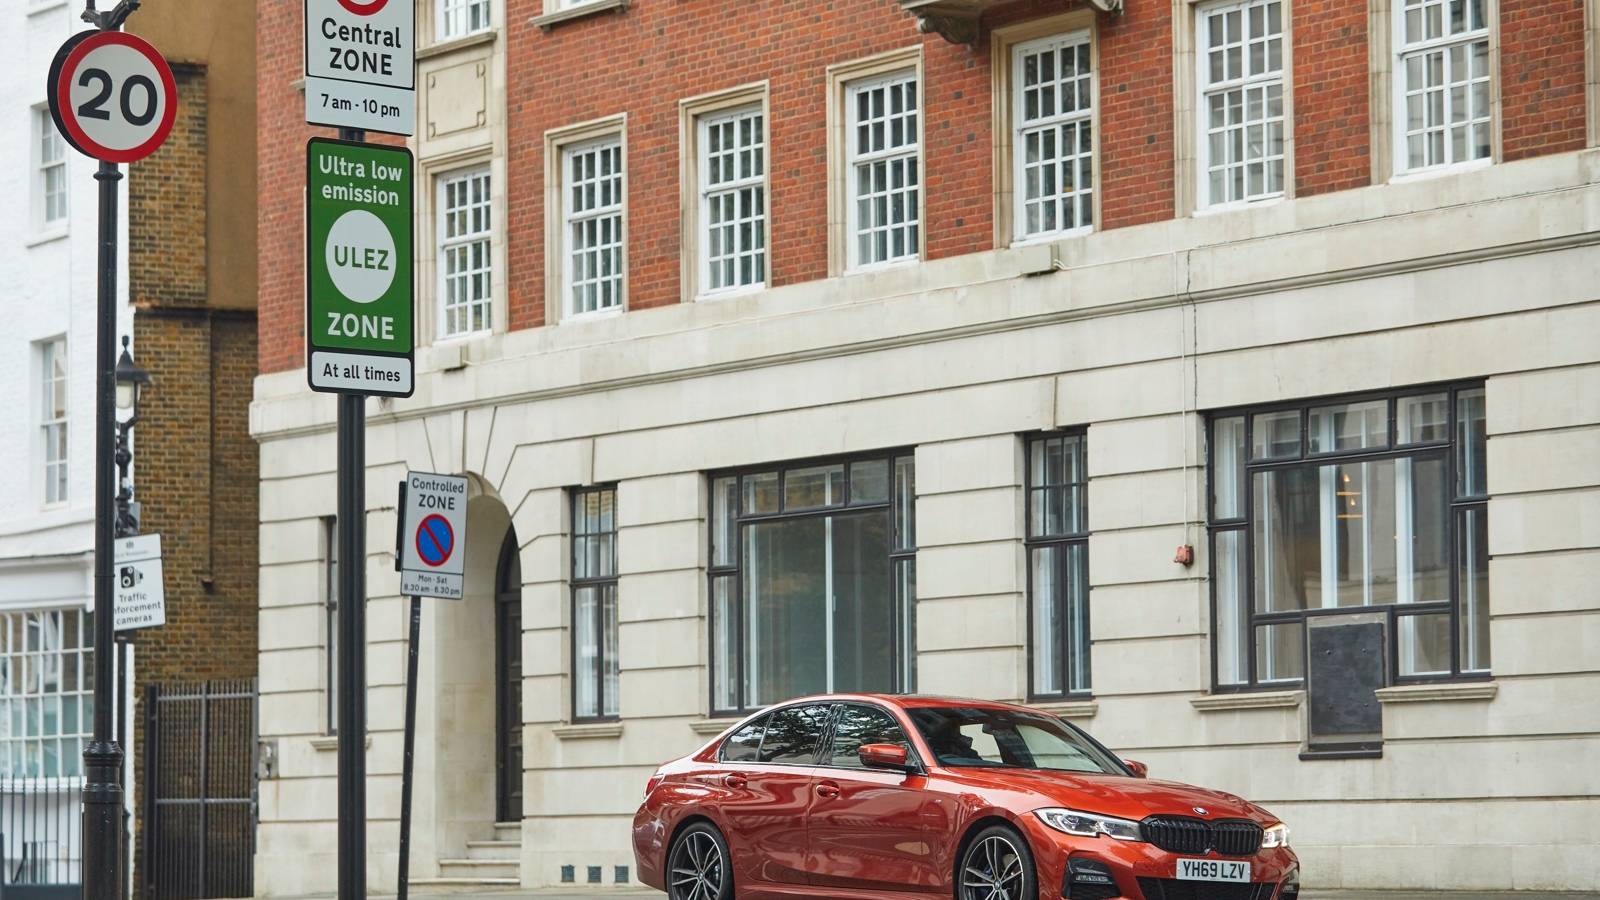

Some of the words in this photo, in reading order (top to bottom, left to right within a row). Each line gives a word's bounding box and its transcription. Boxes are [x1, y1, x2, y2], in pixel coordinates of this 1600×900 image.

[321, 17, 401, 48] Central
[329, 47, 393, 76] ZONE
[78, 67, 158, 127] 20
[362, 98, 378, 114] 10
[381, 104, 400, 118] pm
[319, 154, 366, 178] Ultra
[371, 160, 402, 182] low
[321, 182, 399, 206] emission
[334, 245, 389, 271] ULEZ
[327, 311, 395, 340] ZONE
[323, 362, 339, 378] At
[343, 365, 360, 380] all
[364, 366, 401, 382] times
[412, 477, 464, 493] Controlled
[418, 493, 455, 511] ZONE
[418, 574, 432, 583] Mon
[436, 576, 447, 584] Sat
[114, 600, 161, 614] nforcement
[119, 592, 147, 602] Traffic
[116, 614, 152, 625] cameras
[1183, 861, 1218, 878] YH69
[1221, 863, 1245, 879] LZV
